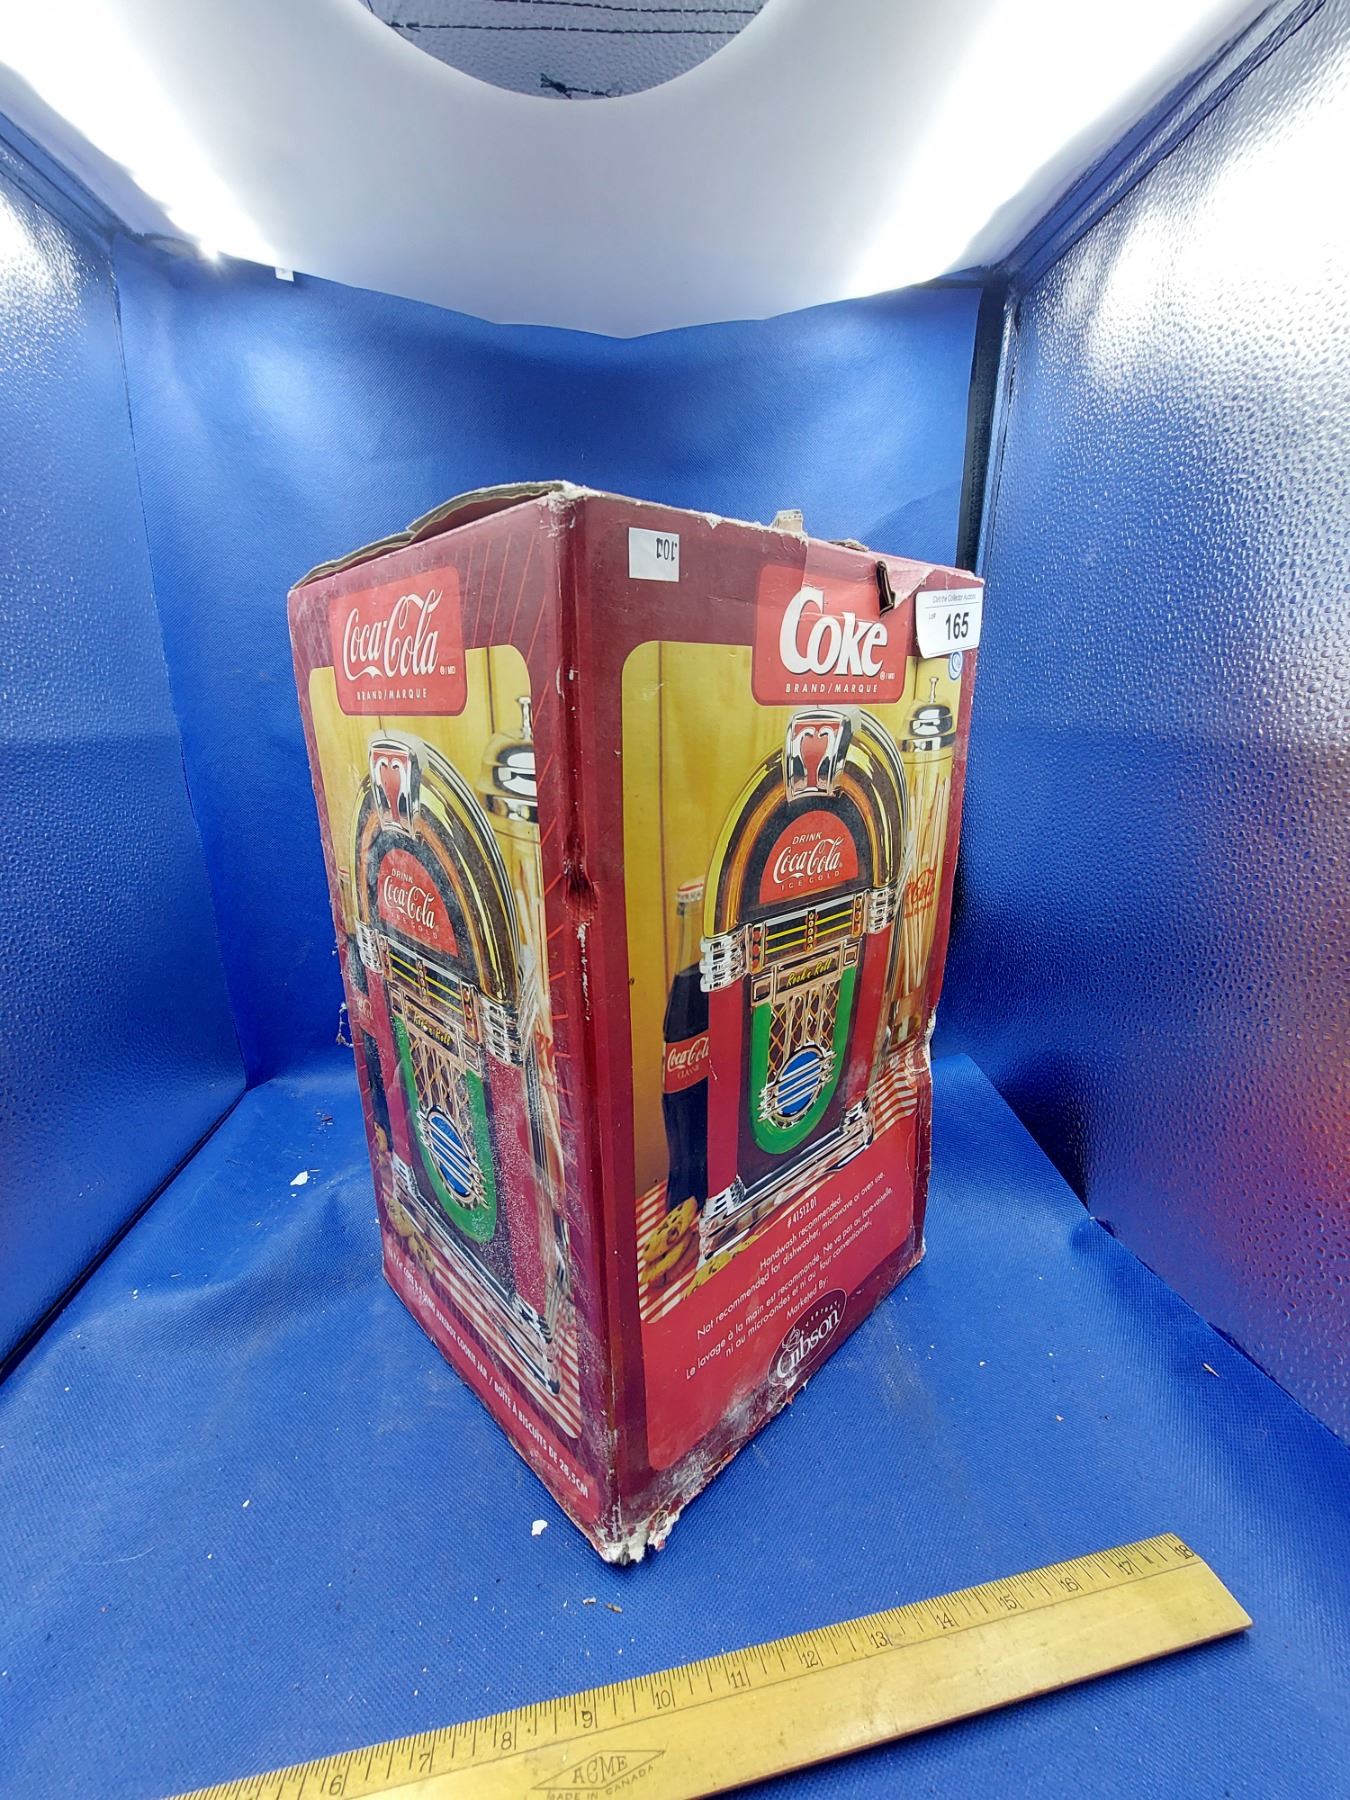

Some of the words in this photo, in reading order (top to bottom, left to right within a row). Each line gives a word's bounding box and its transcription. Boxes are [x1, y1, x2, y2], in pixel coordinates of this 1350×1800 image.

[342, 589, 443, 681] Coca-Cola
[779, 586, 888, 677] Coke
[945, 611, 970, 641] 165
[356, 687, 428, 700] BRAND/MARQUE
[785, 683, 879, 694] BRAND/MARQUE
[792, 832, 823, 845] DRINK
[391, 867, 414, 884] DRINK
[772, 836, 845, 884] Coca-Cola
[383, 875, 435, 930] Coca-Cola
[760, 1233, 797, 1271] Handwash
[696, 1320, 714, 1340] Not
[715, 1272, 770, 1325] recommended
[786, 1284, 818, 1320] Marketed
[685, 1366, 696, 1380] Le
[697, 1339, 726, 1368] lavage
[735, 1323, 744, 1334] la
[745, 1304, 764, 1325] main
[766, 1292, 776, 1307] est
[725, 1344, 734, 1357] ni
[735, 1335, 746, 1348] au
[747, 1294, 791, 1337] micro-ondes
[776, 1309, 840, 1379] Gibson
[548, 1445, 558, 1464] DE
[329, 1774, 343, 1797] 6
[418, 1752, 431, 1773] 7
[500, 1731, 512, 1751] 8
[581, 1710, 593, 1729] 9
[654, 1689, 672, 1710] 10
[730, 1669, 746, 1689] 11
[801, 1650, 818, 1669] 12
[870, 1630, 888, 1649] 13
[936, 1612, 954, 1630] 14
[1000, 1594, 1017, 1611] 15
[1060, 1577, 1079, 1593] 16
[1117, 1560, 1134, 1575] 17
[1174, 1544, 1195, 1560] 18
[572, 1755, 628, 1784] ACME
[605, 1764, 654, 1796] CANADA
